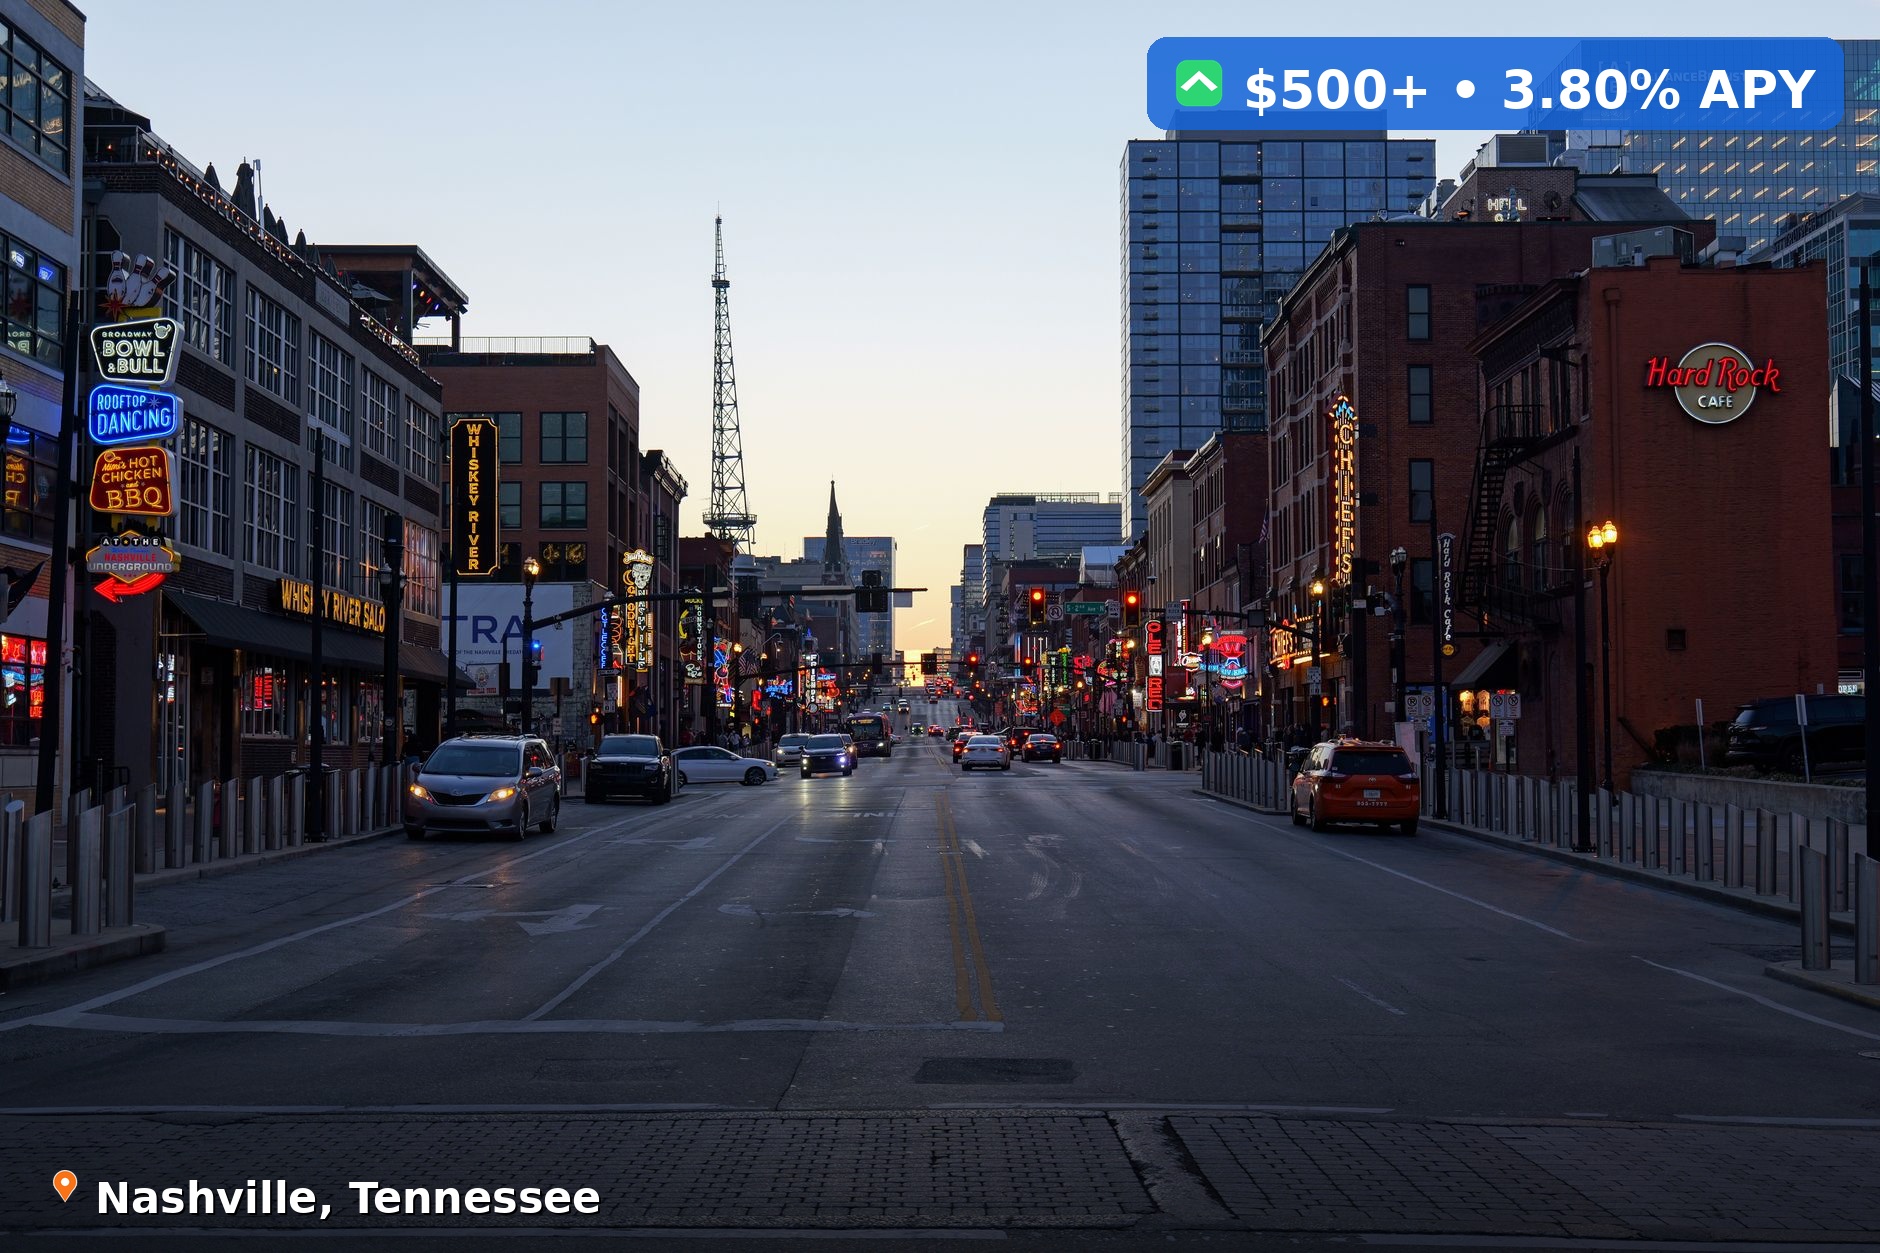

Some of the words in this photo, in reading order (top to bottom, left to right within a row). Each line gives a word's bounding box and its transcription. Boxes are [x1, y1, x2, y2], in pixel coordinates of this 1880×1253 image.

[102, 340, 165, 357] BOWL
[117, 357, 164, 373] BULL
[1647, 356, 1713, 387] Hard
[1715, 356, 1782, 392] Rock
[97, 394, 147, 411] ROOFTOP
[1697, 395, 1733, 408] CAFE
[97, 408, 171, 435] DANCING
[129, 455, 158, 468] HOT
[466, 423, 482, 506] WHISKEY
[101, 467, 162, 484] CHICKEN
[125, 481, 139, 489] and
[105, 486, 164, 509] BBQ
[102, 538, 119, 546] AT
[133, 538, 159, 546] THE
[467, 511, 479, 570] RIVER
[104, 553, 156, 562] NASHVILLE
[1443, 538, 1451, 567] Hard
[88, 562, 172, 571] UNDERGROUND
[1443, 572, 1451, 606] Rock
[281, 578, 330, 618] WHISY
[333, 592, 361, 627] RIVER
[1443, 609, 1452, 641] Cafe
[1147, 621, 1162, 655] OLE
